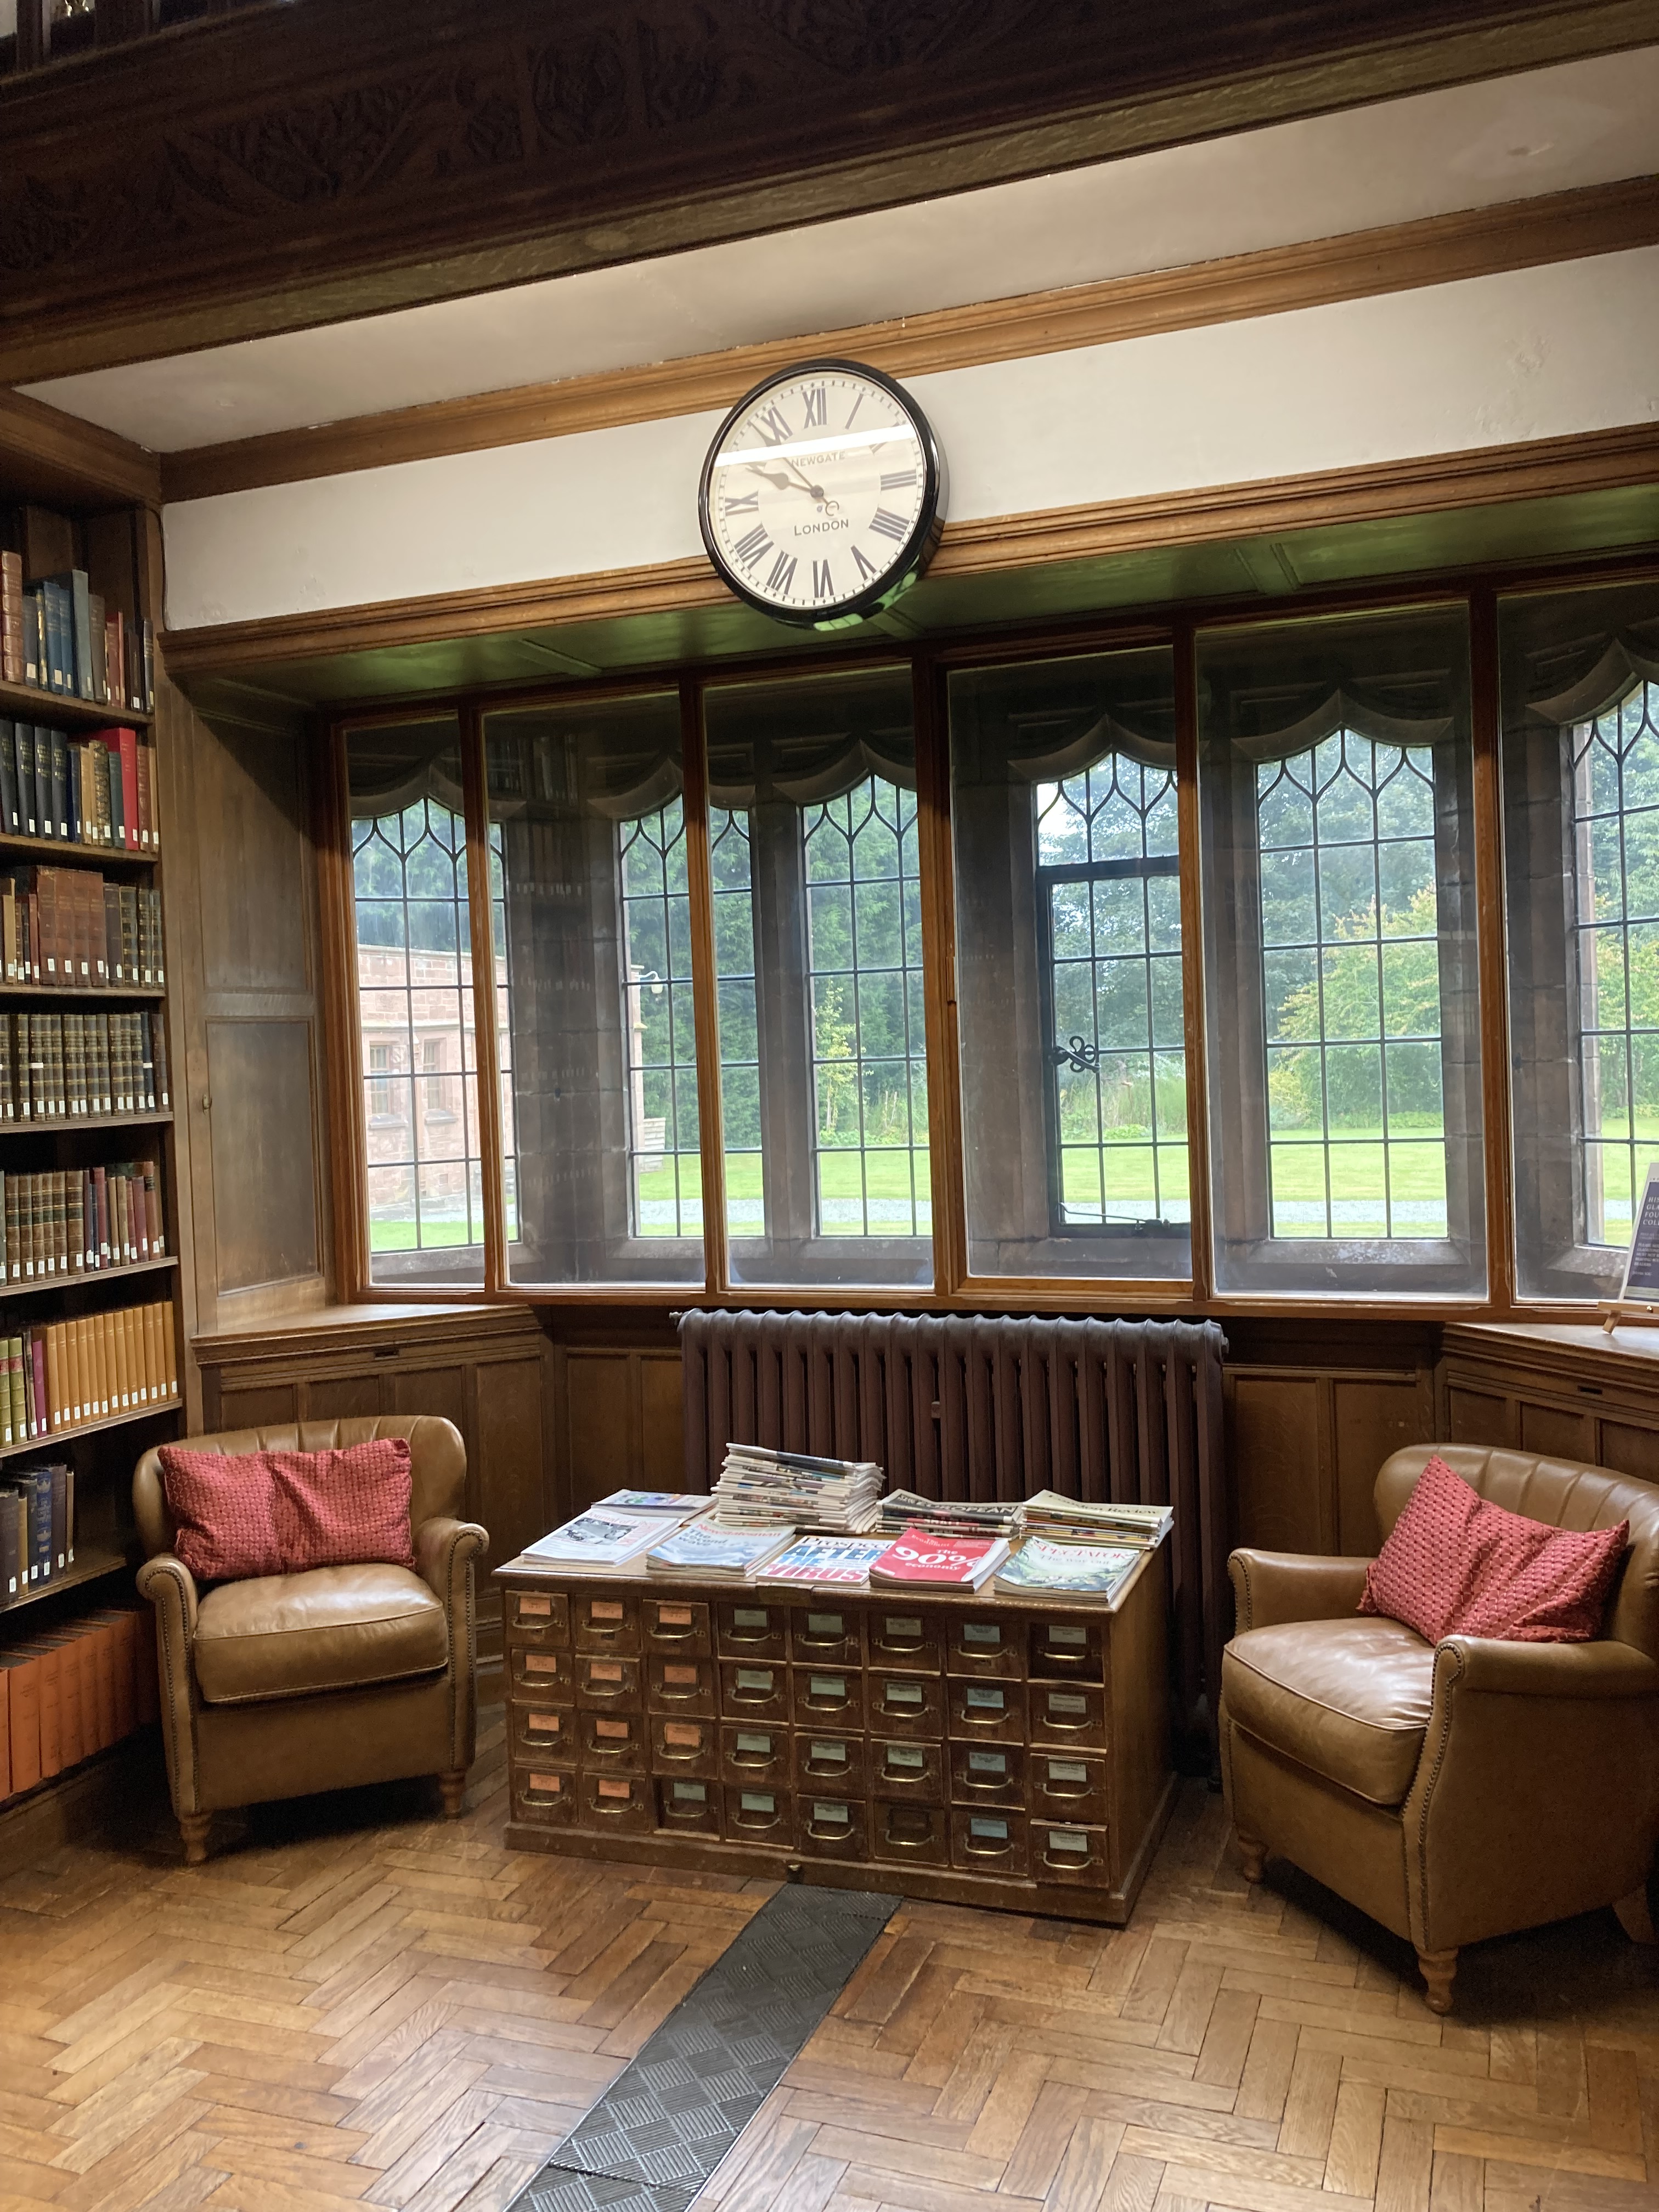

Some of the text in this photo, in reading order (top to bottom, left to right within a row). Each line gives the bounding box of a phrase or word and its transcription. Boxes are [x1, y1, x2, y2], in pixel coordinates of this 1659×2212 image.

[802, 387, 827, 429] XII
[791, 451, 846, 467] NEWGATE
[794, 519, 849, 537] LONDON
[678, 1537, 712, 1546] wave
[684, 1532, 728, 1544] second
[689, 1528, 712, 1539] The
[785, 1545, 888, 1561] AFTER
[892, 1547, 983, 1567] 90%
[1033, 1541, 1128, 1559] SPECTATOR
[776, 1555, 826, 1567] THE
[905, 1562, 961, 1571] economy
[767, 1564, 868, 1581] VIRUS
